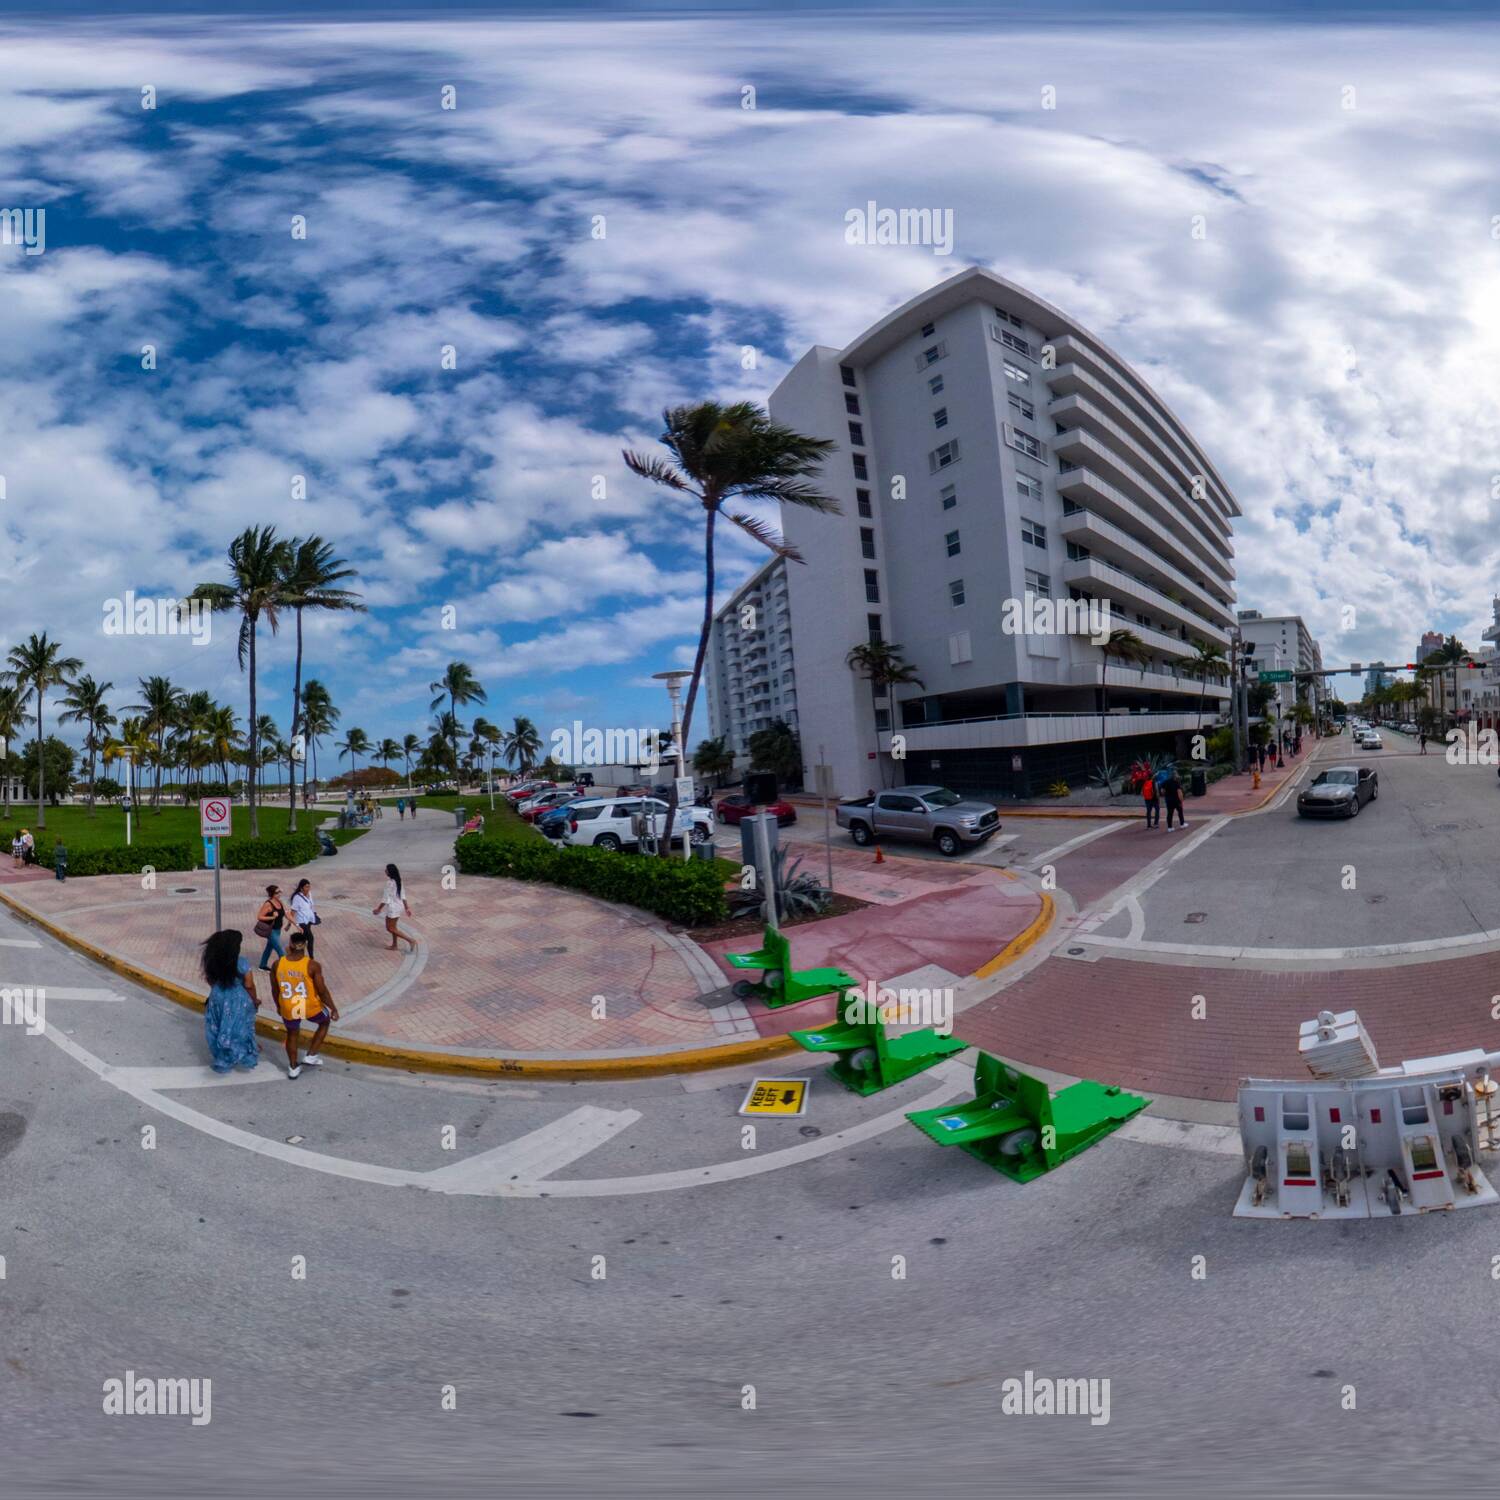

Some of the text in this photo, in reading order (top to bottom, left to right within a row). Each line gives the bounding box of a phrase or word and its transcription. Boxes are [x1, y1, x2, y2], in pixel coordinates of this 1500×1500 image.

[280, 981, 307, 999] 34
[750, 1086, 767, 1106] KEEP
[763, 1087, 779, 1106] LEFT
